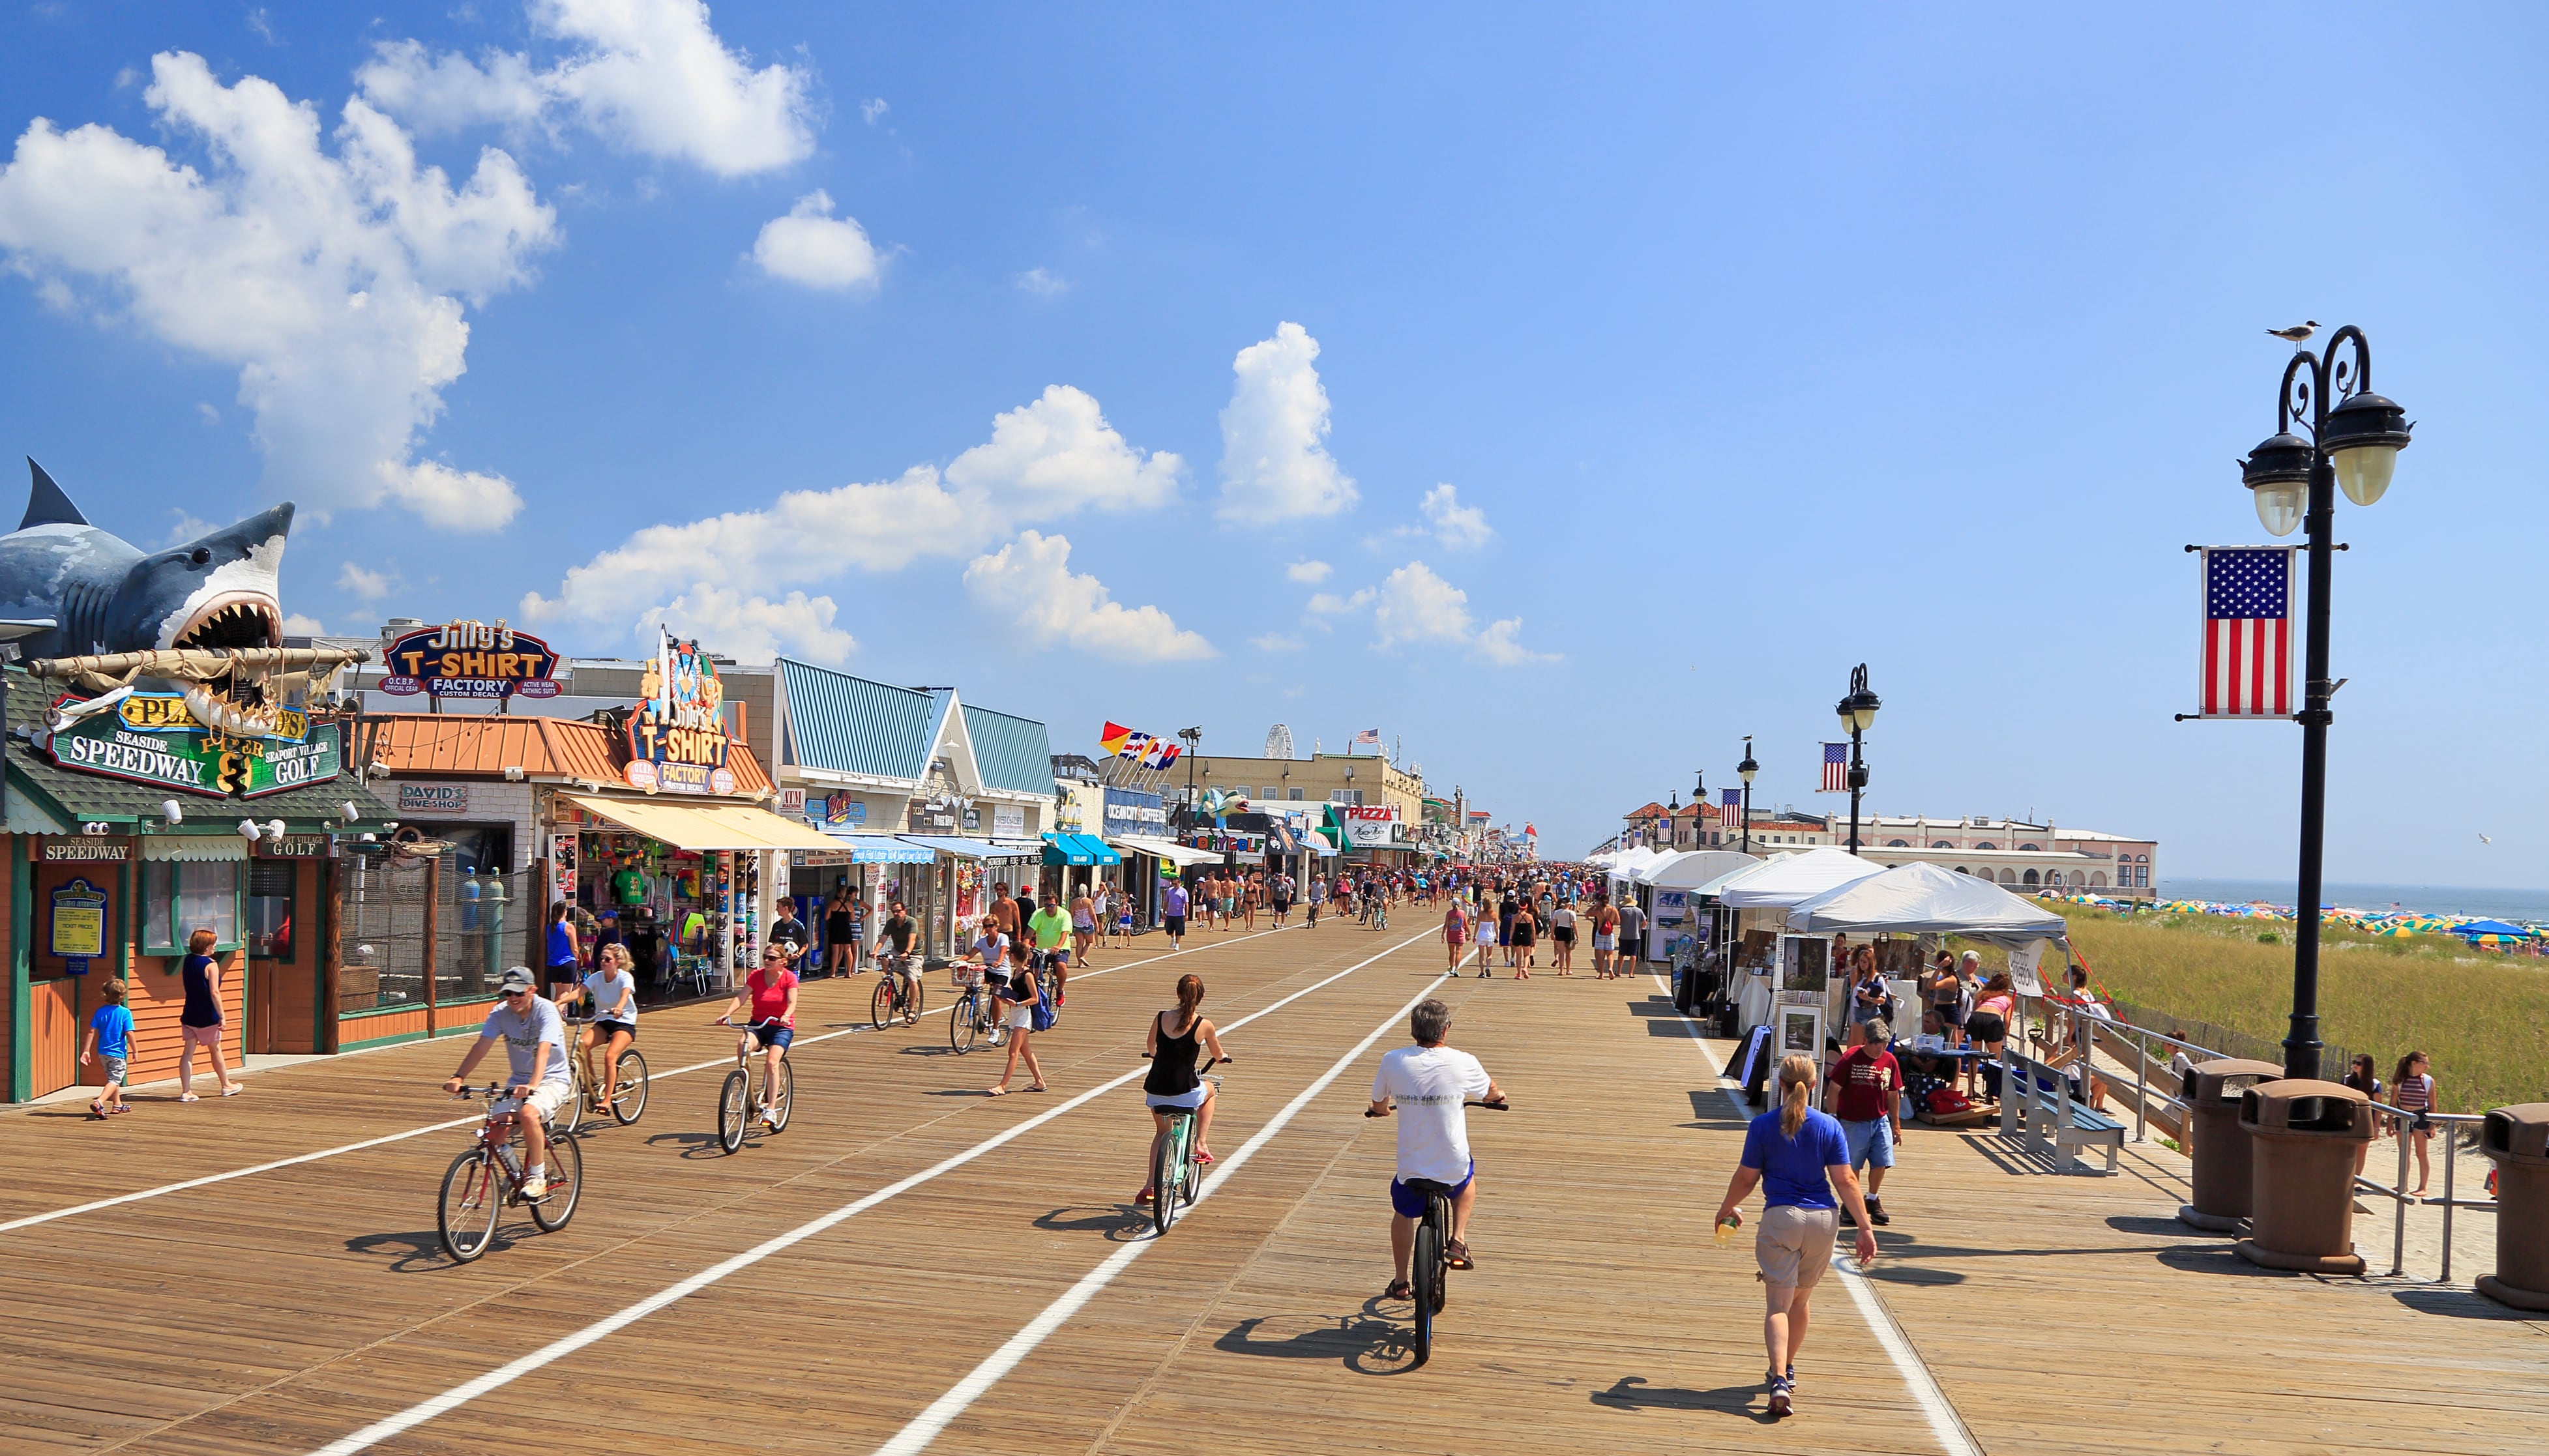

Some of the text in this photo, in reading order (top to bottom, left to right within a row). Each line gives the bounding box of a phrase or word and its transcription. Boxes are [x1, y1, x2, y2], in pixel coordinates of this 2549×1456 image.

[428, 619, 514, 650] Jilly's
[400, 651, 543, 678] T-SHIRT
[389, 677, 415, 686] O.C.B.P.
[433, 678, 508, 692] FACTORY
[115, 731, 168, 752] SEASIDE
[640, 725, 727, 766] T-SHIRT
[70, 736, 206, 785] SPEEDWAY
[265, 742, 328, 764] SEAPORT VILLAGE
[275, 755, 319, 785] GOLF
[663, 764, 707, 784] FACTORY
[403, 786, 464, 800] DAVID'S
[669, 782, 686, 791] USTOM
[782, 791, 801, 804] ATM
[1108, 804, 1127, 820] OCEAN
[1127, 806, 1138, 821] CITY
[1141, 808, 1159, 822] COFFEE
[1349, 807, 1392, 821] PIZZA
[70, 837, 105, 846] SEASIDE
[273, 843, 316, 855] GOLF
[1229, 836, 1265, 853] GOLF
[46, 845, 128, 860] SPEEDWAY
